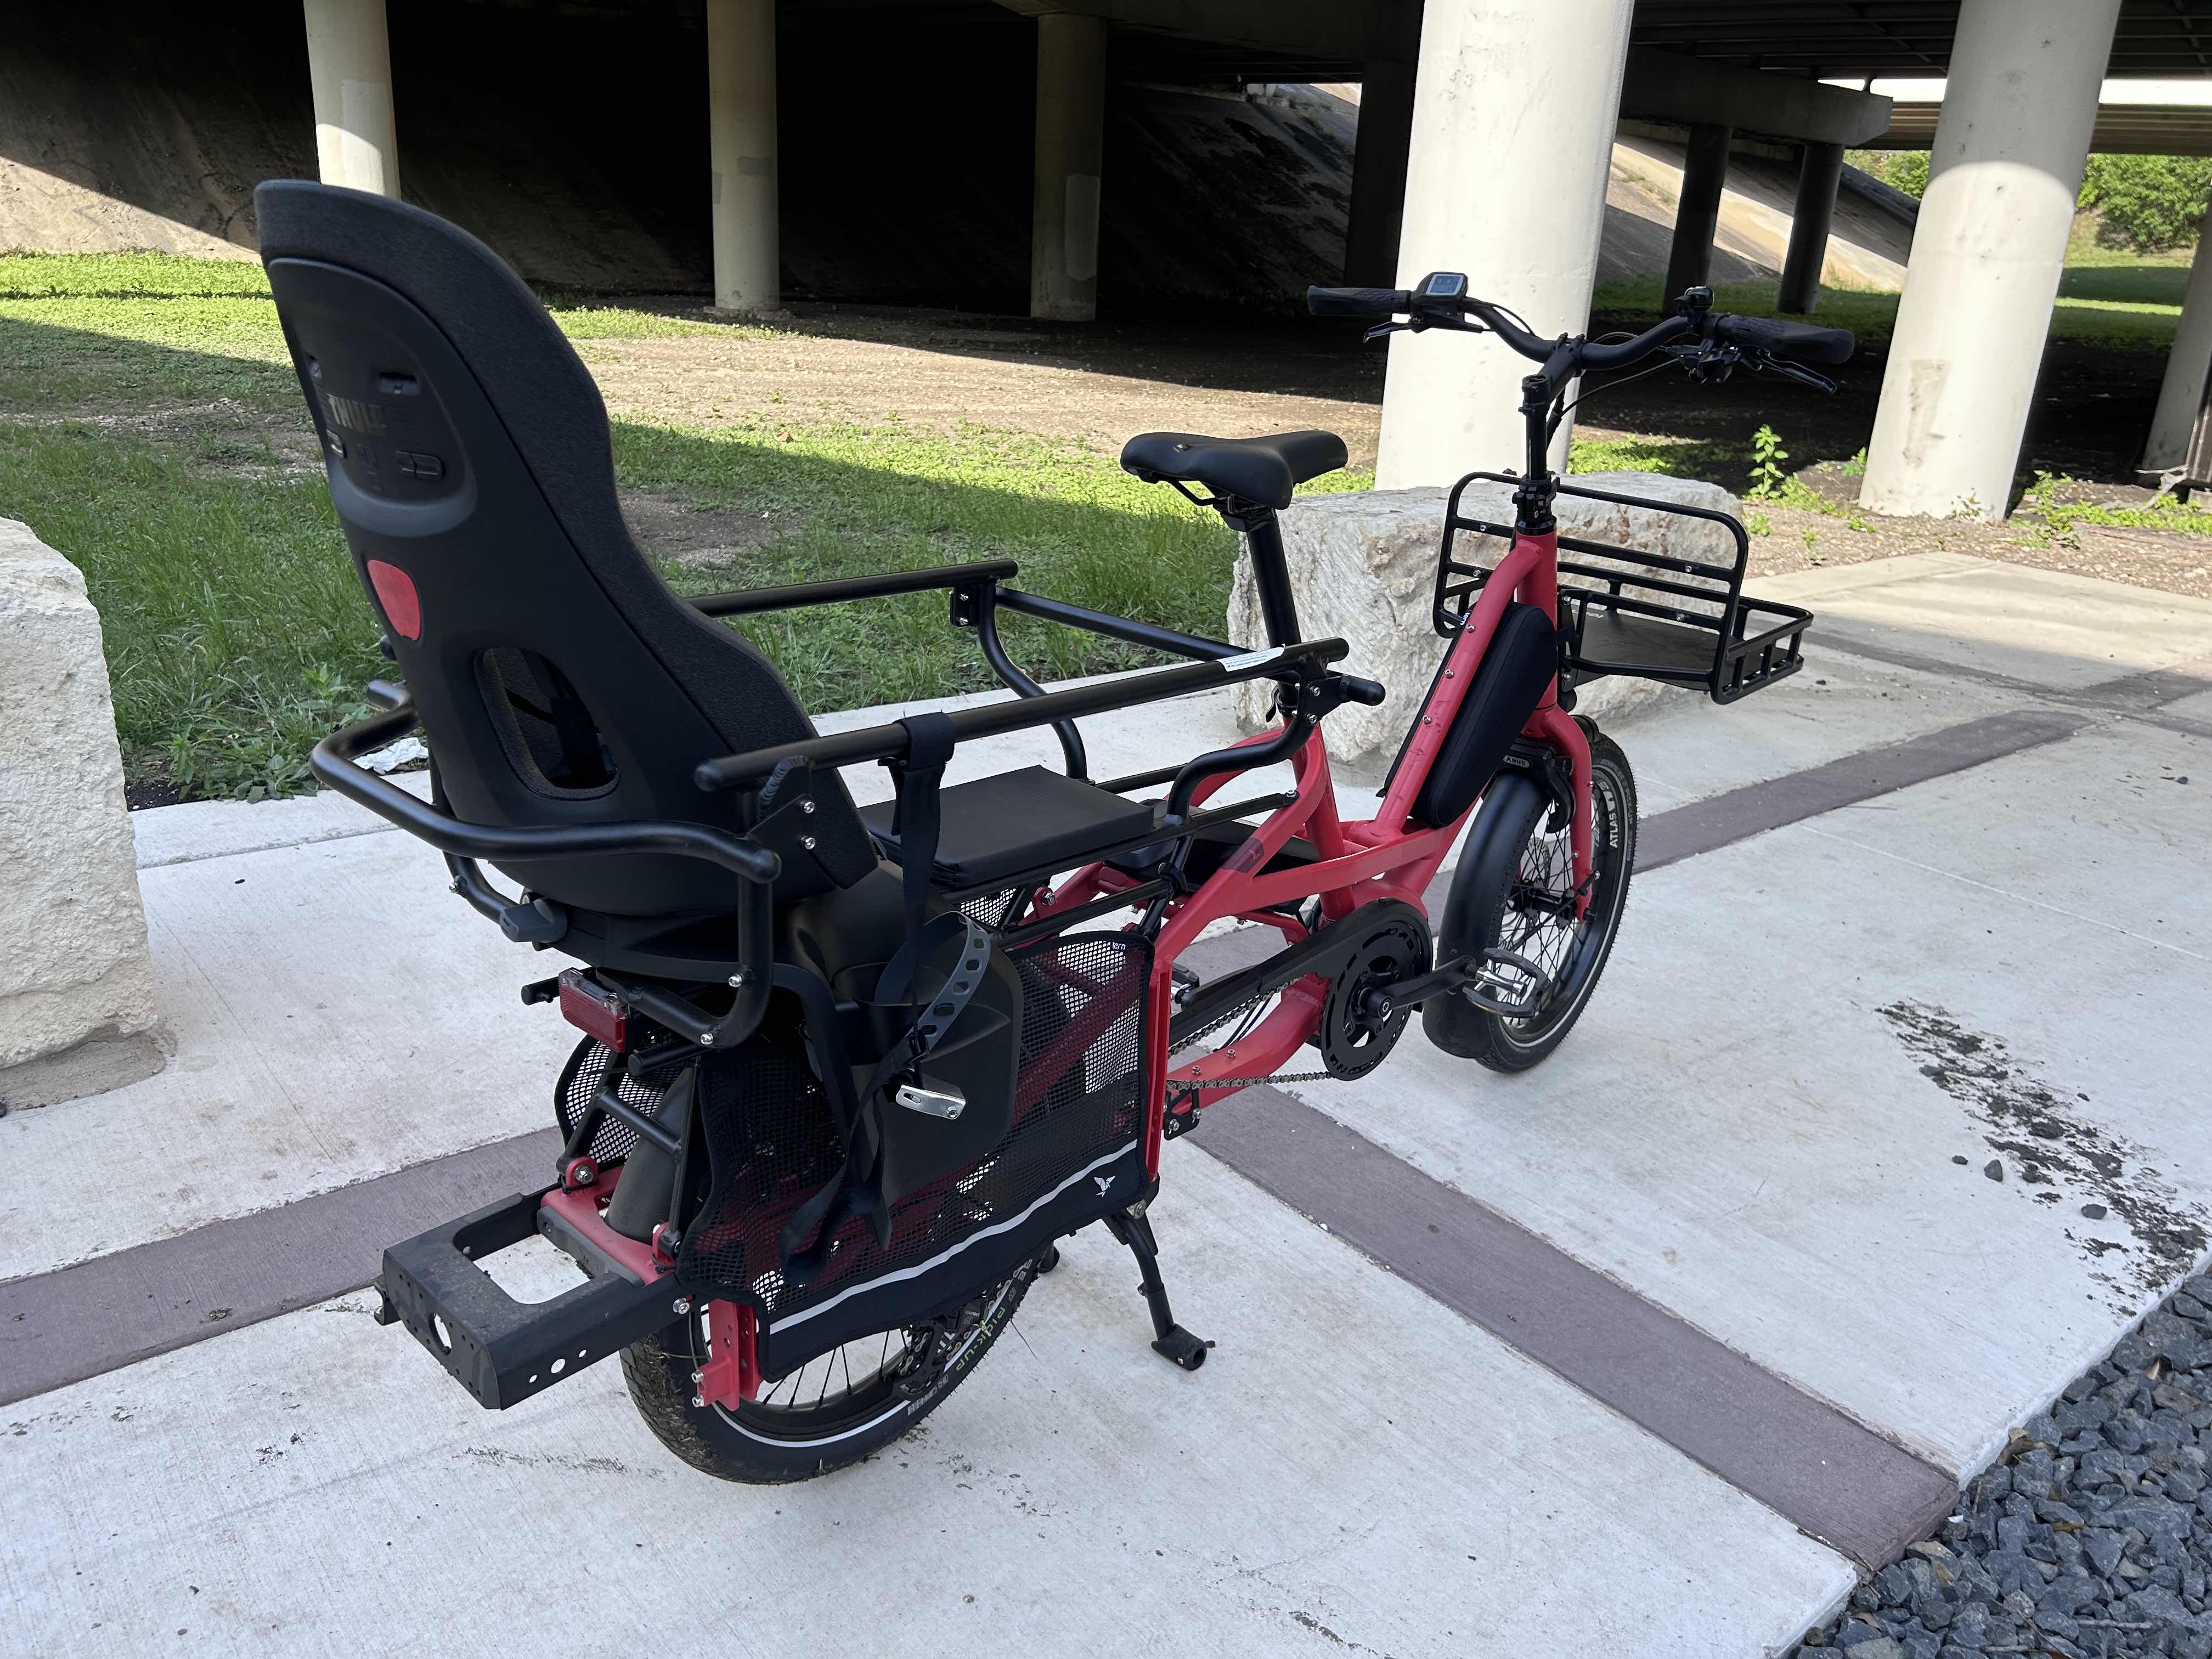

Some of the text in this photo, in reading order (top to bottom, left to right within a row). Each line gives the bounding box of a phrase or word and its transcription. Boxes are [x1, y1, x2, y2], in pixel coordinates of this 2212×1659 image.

[1505, 757, 1528, 766] ABUS
[1609, 812, 1618, 849] ATLAS
[1112, 941, 1126, 950] tern
